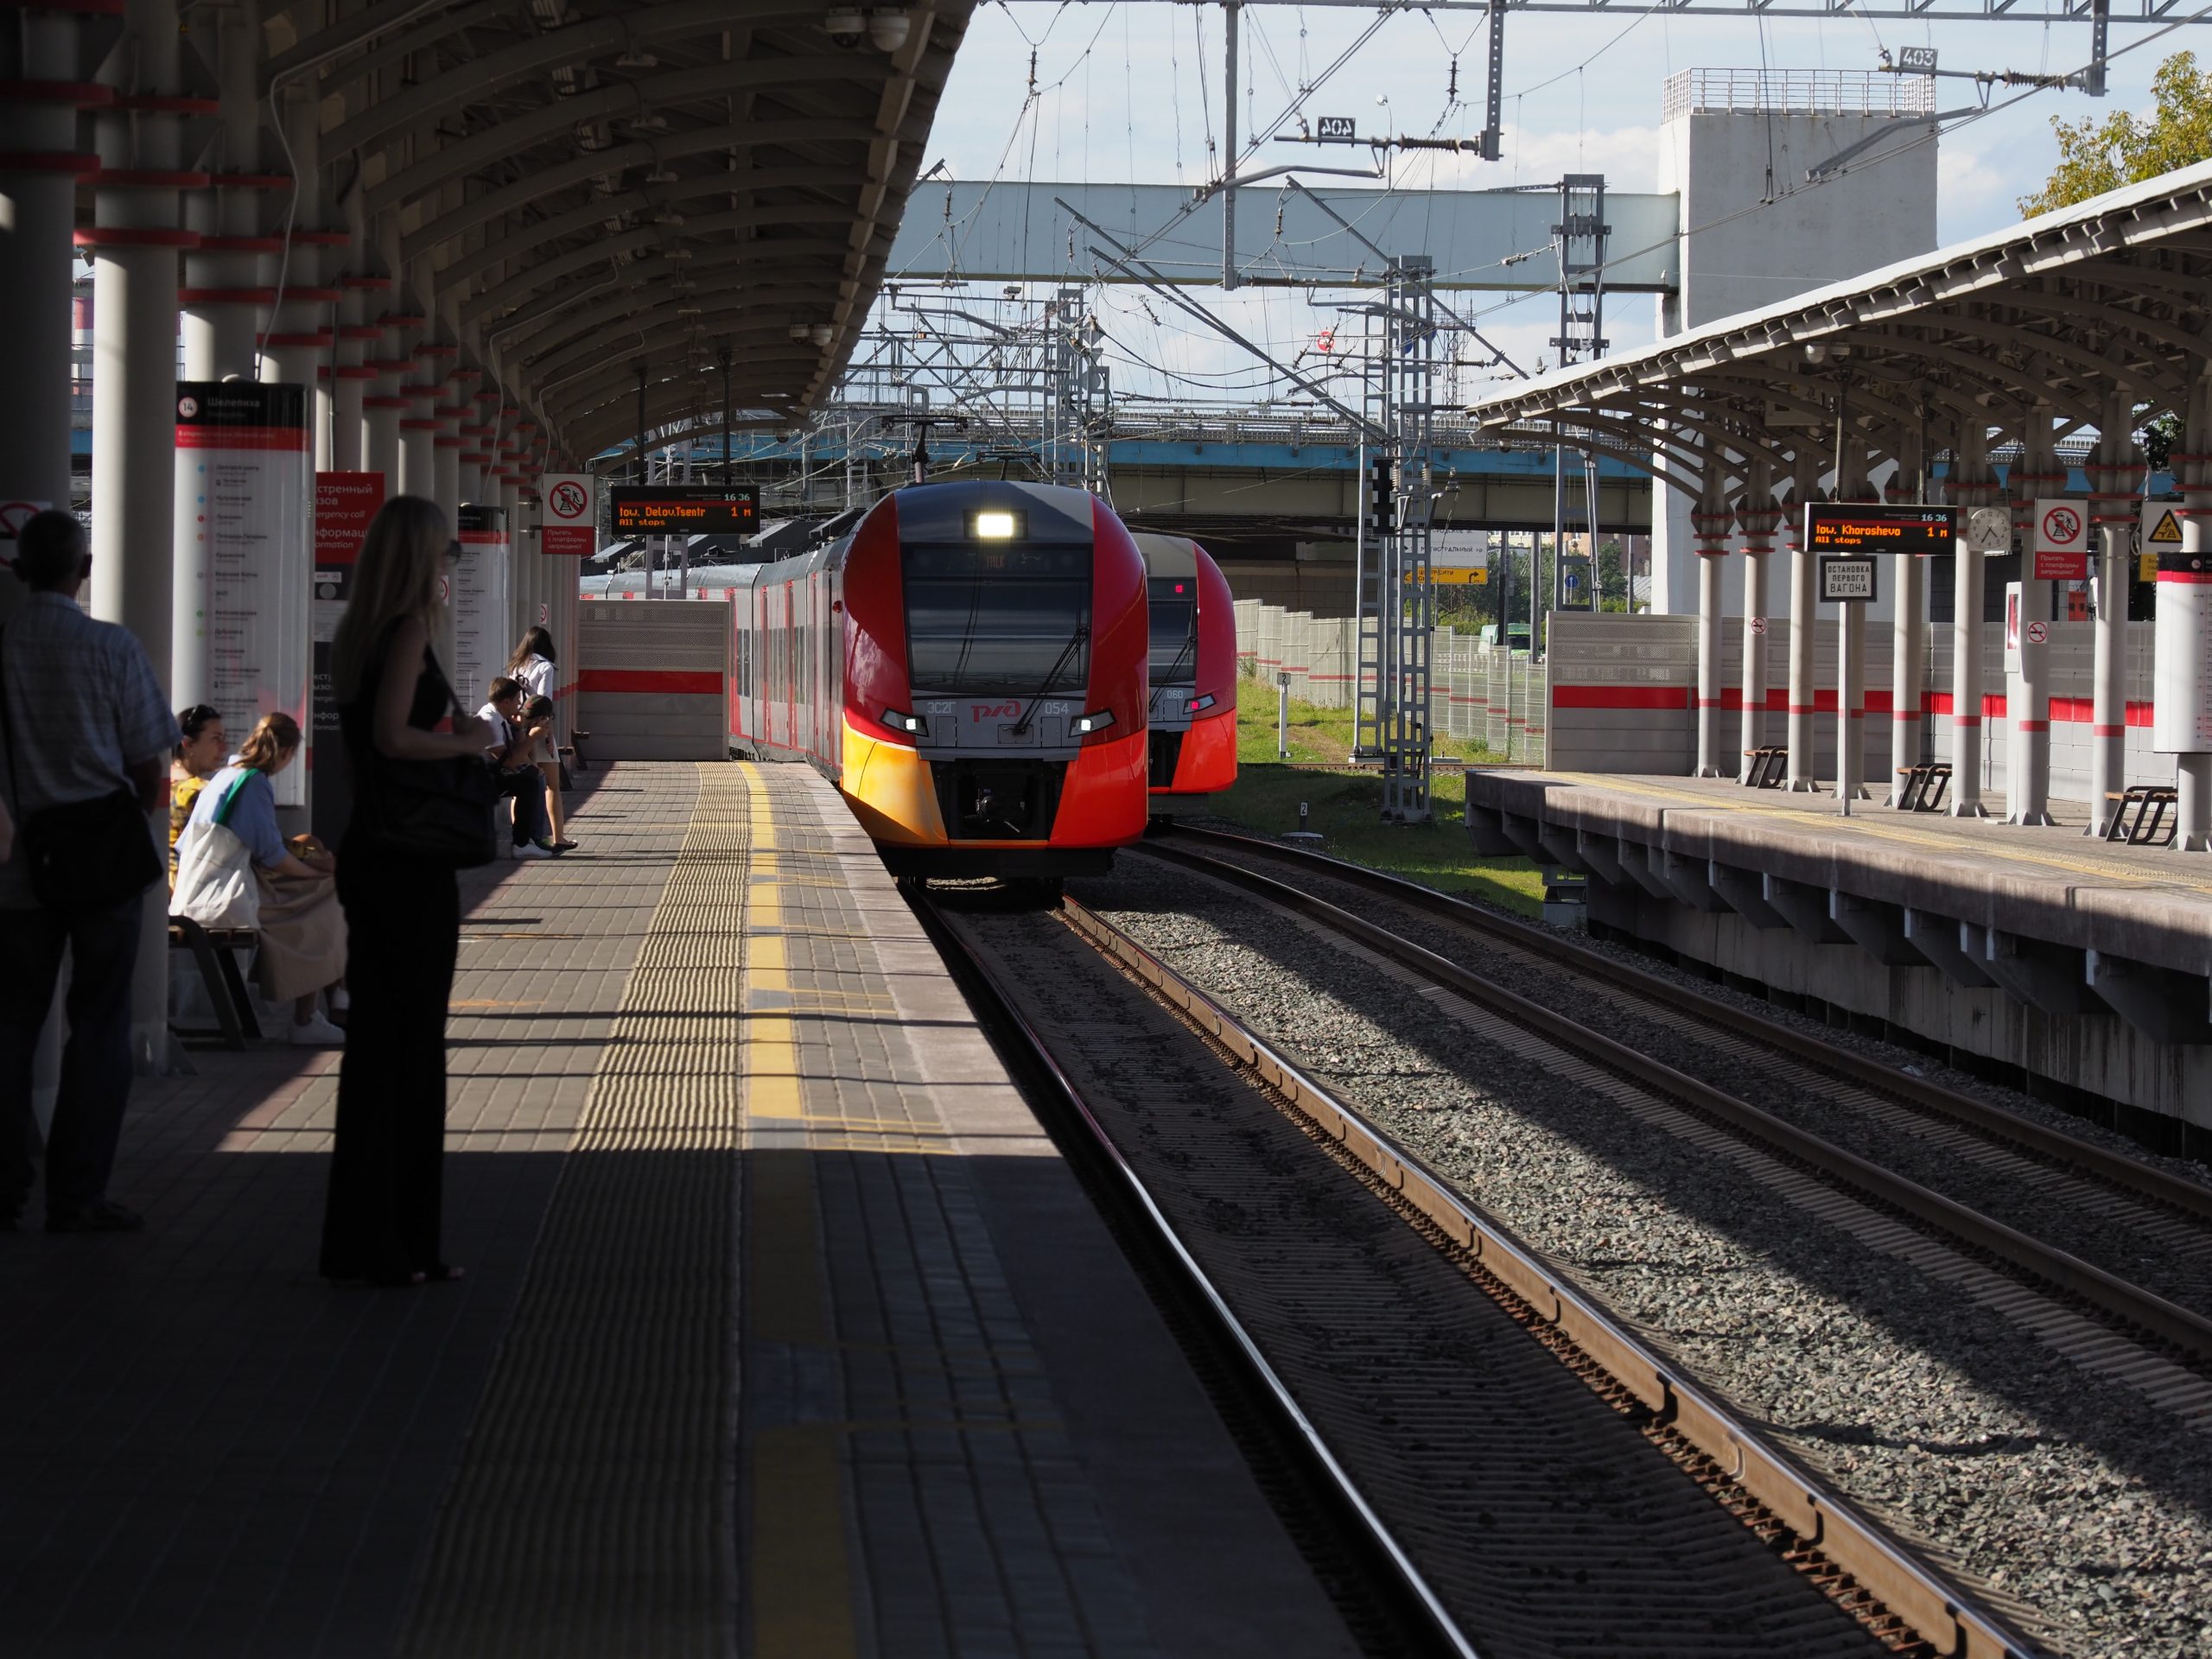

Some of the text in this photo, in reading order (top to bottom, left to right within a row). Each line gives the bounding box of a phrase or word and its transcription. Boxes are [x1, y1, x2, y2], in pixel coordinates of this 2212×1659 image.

[1903, 48, 1935, 67] 403
[182, 402, 194, 412] 14
[207, 397, 261, 408] Шелепиха
[738, 493, 750, 502] 36
[349, 510, 365, 518] call
[620, 506, 640, 517] tow.
[645, 506, 706, 517] Delov.Tsentr
[731, 506, 738, 517] 1
[1921, 513, 1933, 522] 16
[1936, 514, 1948, 523] 36
[547, 529, 572, 537] Прыгать
[1815, 524, 1837, 535] tow.
[1841, 524, 1901, 536] Khoroshevo
[1927, 527, 1935, 537] 1
[552, 536, 587, 544] платформы
[1827, 565, 1871, 574] ОСТАНОВКА
[1830, 583, 1867, 593] ВАГОНА
[1281, 674, 1287, 683] 2
[1166, 690, 1184, 699] 060
[1045, 702, 1070, 715] 054
[1301, 804, 1306, 815] 2
